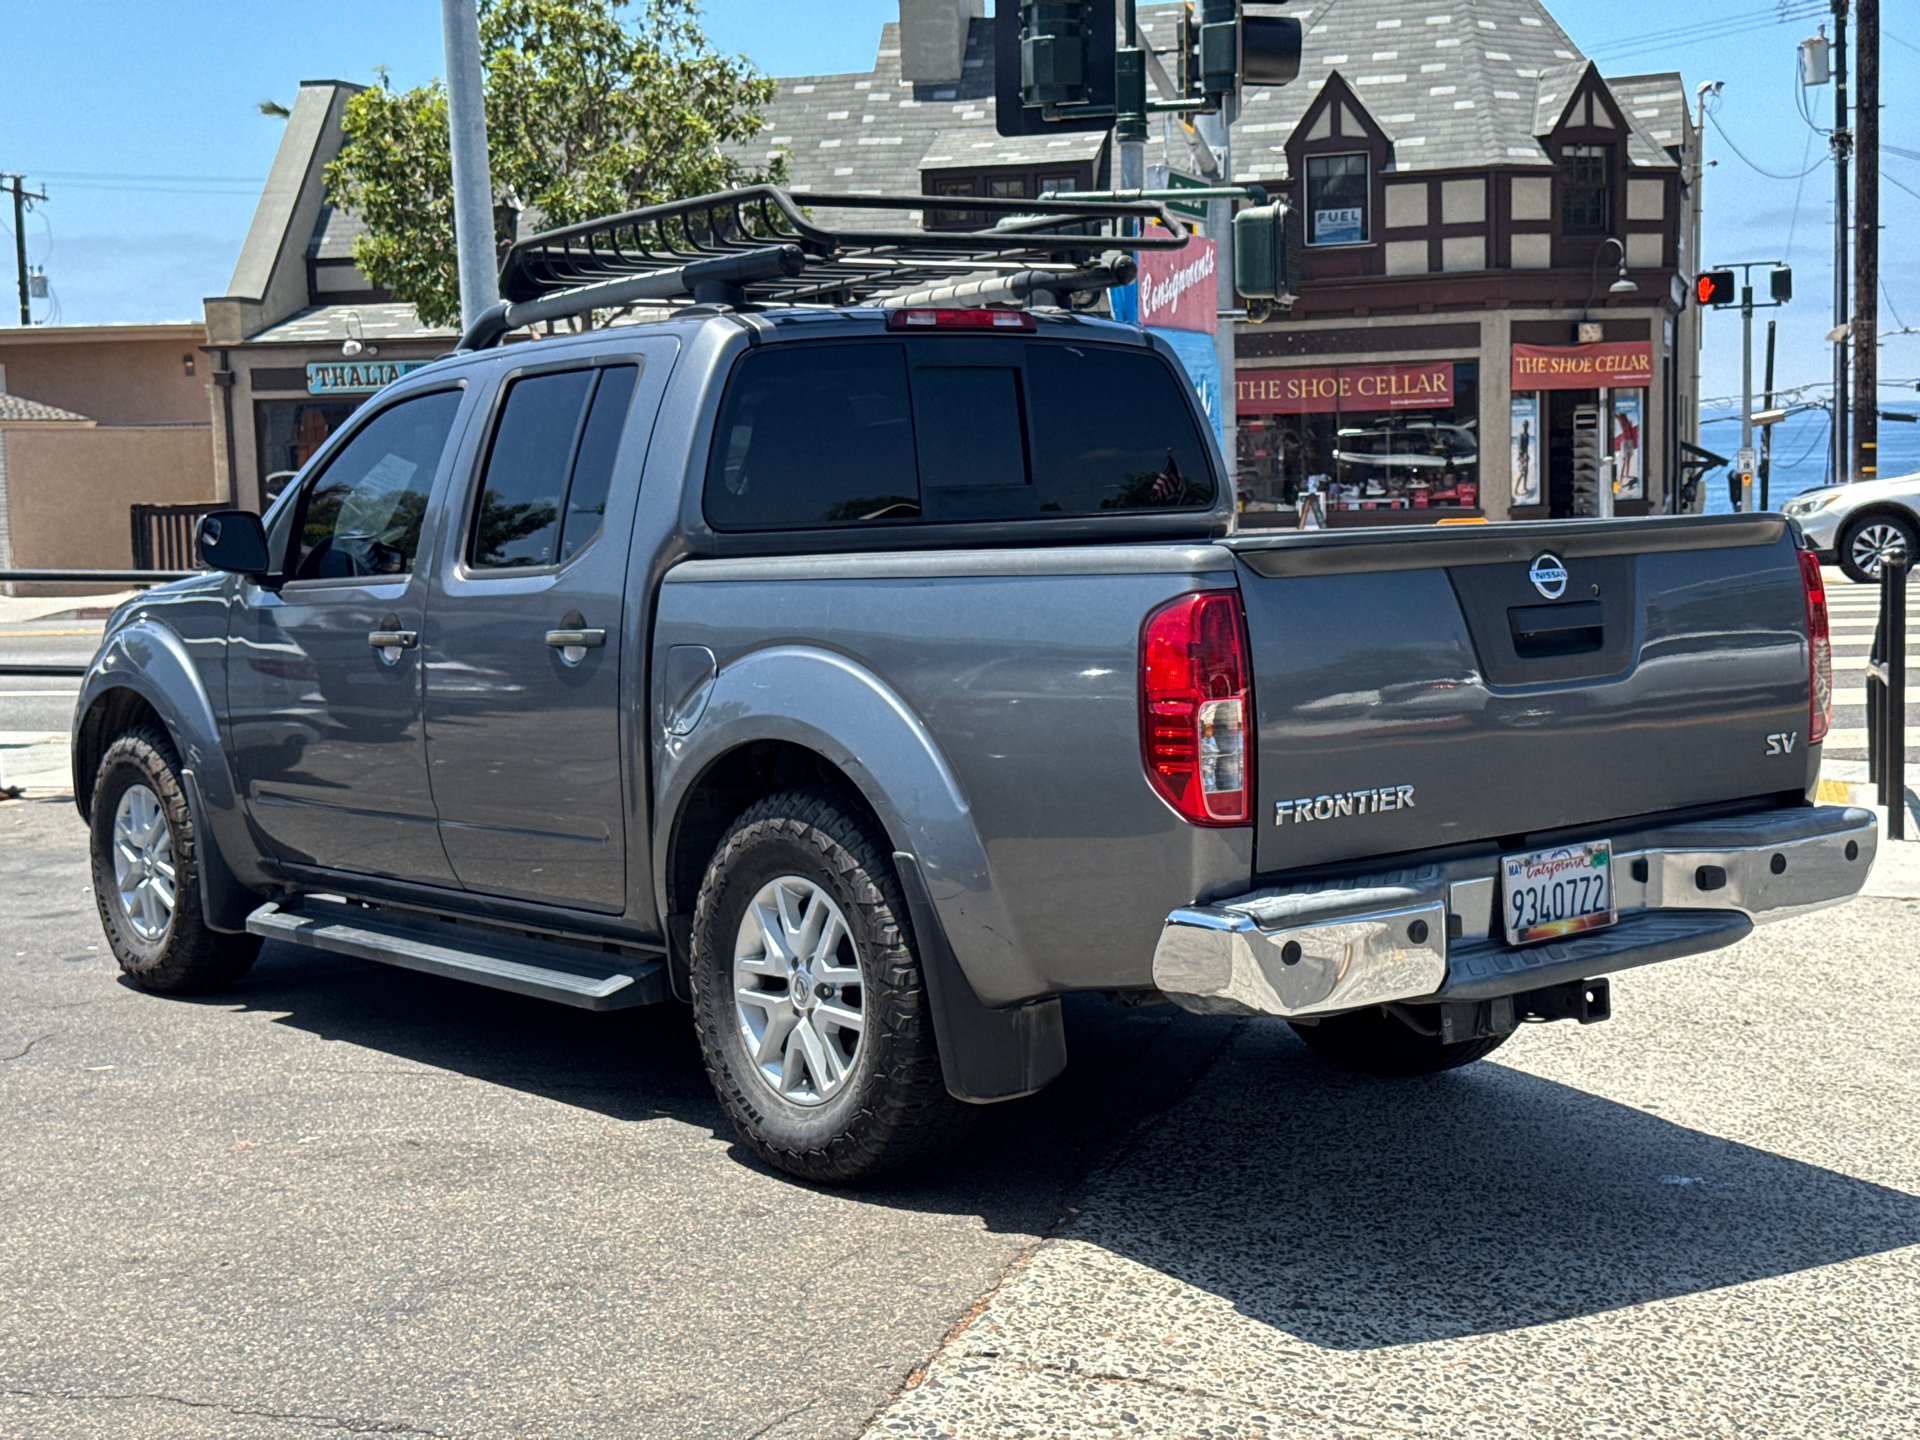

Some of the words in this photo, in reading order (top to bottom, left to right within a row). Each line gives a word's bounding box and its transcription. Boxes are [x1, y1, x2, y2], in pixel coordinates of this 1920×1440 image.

[1317, 210, 1359, 223] FUEL
[1141, 246, 1214, 318] Consignments
[1516, 356, 1548, 373] THE
[1550, 356, 1593, 373] SHOE
[1595, 354, 1650, 372] CELLAR
[316, 364, 401, 389] THALIA
[1234, 380, 1281, 400] THE
[1287, 377, 1352, 399] SHOE
[1357, 373, 1448, 396] CELLAR
[1535, 570, 1567, 580] NISSAN
[1765, 731, 1797, 756] SV
[1275, 784, 1416, 826] FRONTIER
[1508, 863, 1523, 877] MAY
[1526, 858, 1591, 881] California
